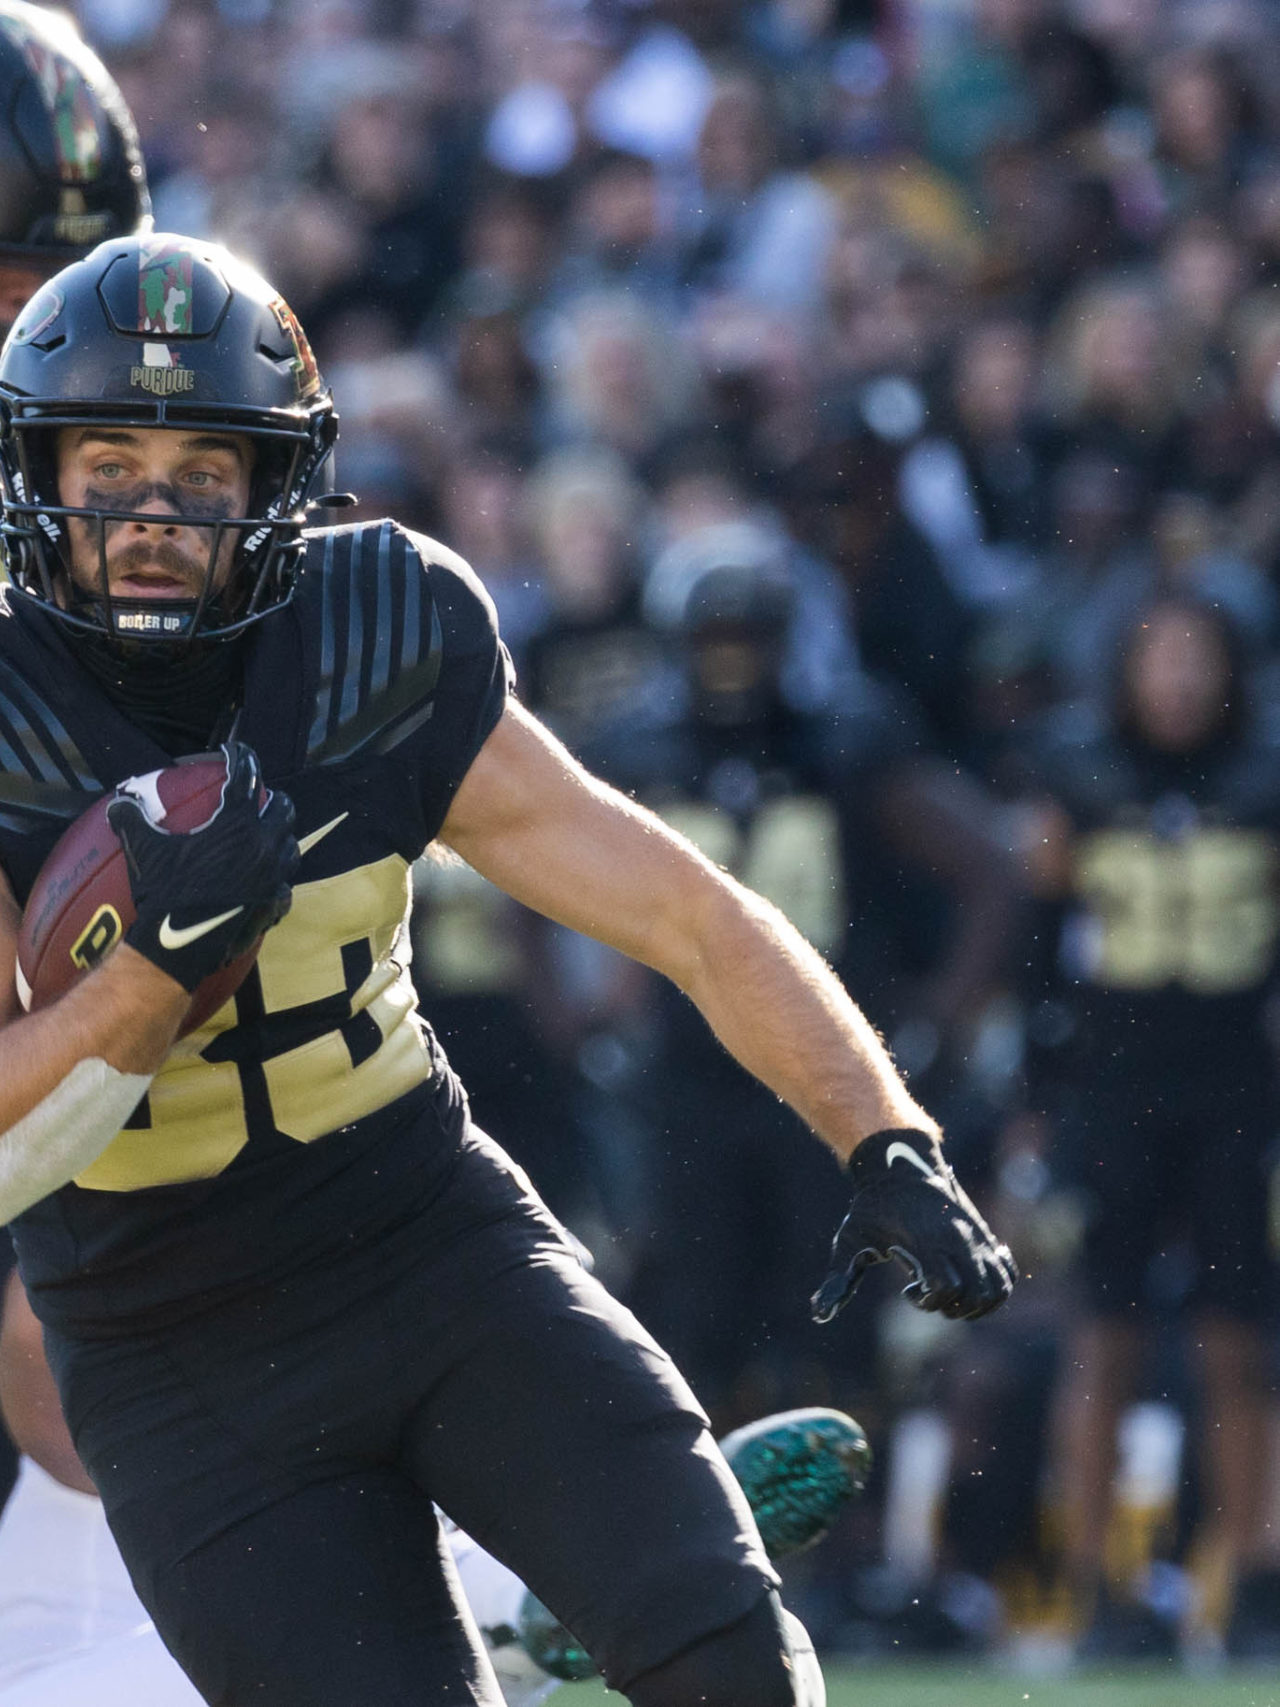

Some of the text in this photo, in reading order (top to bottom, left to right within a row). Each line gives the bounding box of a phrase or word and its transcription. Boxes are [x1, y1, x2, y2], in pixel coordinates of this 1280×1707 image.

[130, 366, 195, 396] PURDUE
[118, 613, 181, 631] BOILER UP
[70, 903, 123, 969] P
